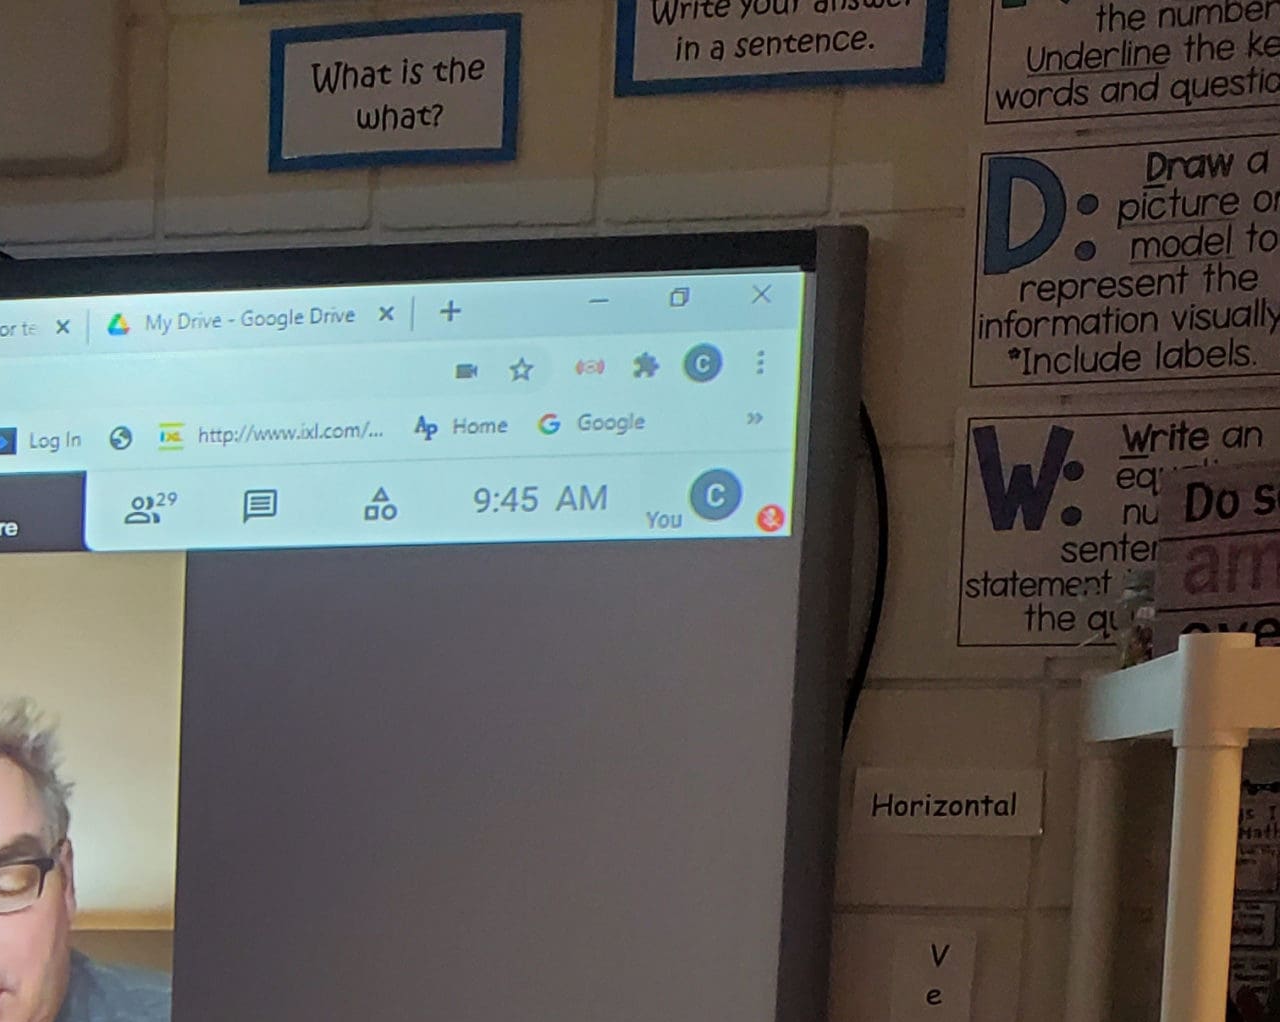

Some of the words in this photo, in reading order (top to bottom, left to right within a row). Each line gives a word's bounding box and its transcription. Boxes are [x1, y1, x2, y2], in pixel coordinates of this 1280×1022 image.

[651, 0, 729, 25] Write
[740, 0, 800, 19] your
[1096, 3, 1145, 32] the
[1158, 0, 1280, 28] number
[676, 35, 700, 61] in
[709, 39, 725, 60] a
[734, 29, 875, 58] sentence.
[1026, 40, 1171, 73] Underline
[1184, 32, 1235, 62] the
[311, 60, 393, 95] What
[401, 58, 424, 85] is
[432, 56, 486, 85] the
[995, 78, 1090, 110] words
[1100, 72, 1160, 103] and
[1170, 66, 1280, 106] questio
[356, 104, 444, 131] what?
[1146, 151, 1235, 182] Draw
[1246, 149, 1269, 175] a
[1117, 187, 1240, 229] picture
[1253, 189, 1280, 213] or
[1131, 224, 1232, 259] model
[1245, 222, 1278, 253] to
[1020, 264, 1189, 307] represent
[1203, 262, 1259, 292] the
[145, 313, 171, 335] My
[178, 312, 222, 330] Drive
[241, 309, 304, 331] Google
[310, 307, 356, 325] Drive
[978, 306, 1159, 339] information
[1171, 297, 1280, 335] visually
[1155, 337, 1258, 370] labels.
[198, 421, 384, 447] http://www.ixl.com/...
[452, 417, 509, 434] Home
[577, 412, 646, 435] Google
[1122, 420, 1210, 452] Write
[1222, 425, 1263, 449] an
[30, 432, 60, 453] Log
[66, 430, 81, 448] In
[156, 492, 178, 507] 29
[473, 486, 539, 513] 9:45
[555, 485, 608, 512] AM
[1186, 482, 1239, 523] Do
[1254, 483, 1280, 516] s
[646, 511, 683, 530] You
[1060, 533, 1158, 563] sente
[965, 569, 1112, 598] statement
[1025, 603, 1075, 632] the
[871, 792, 1018, 819] Horizontal
